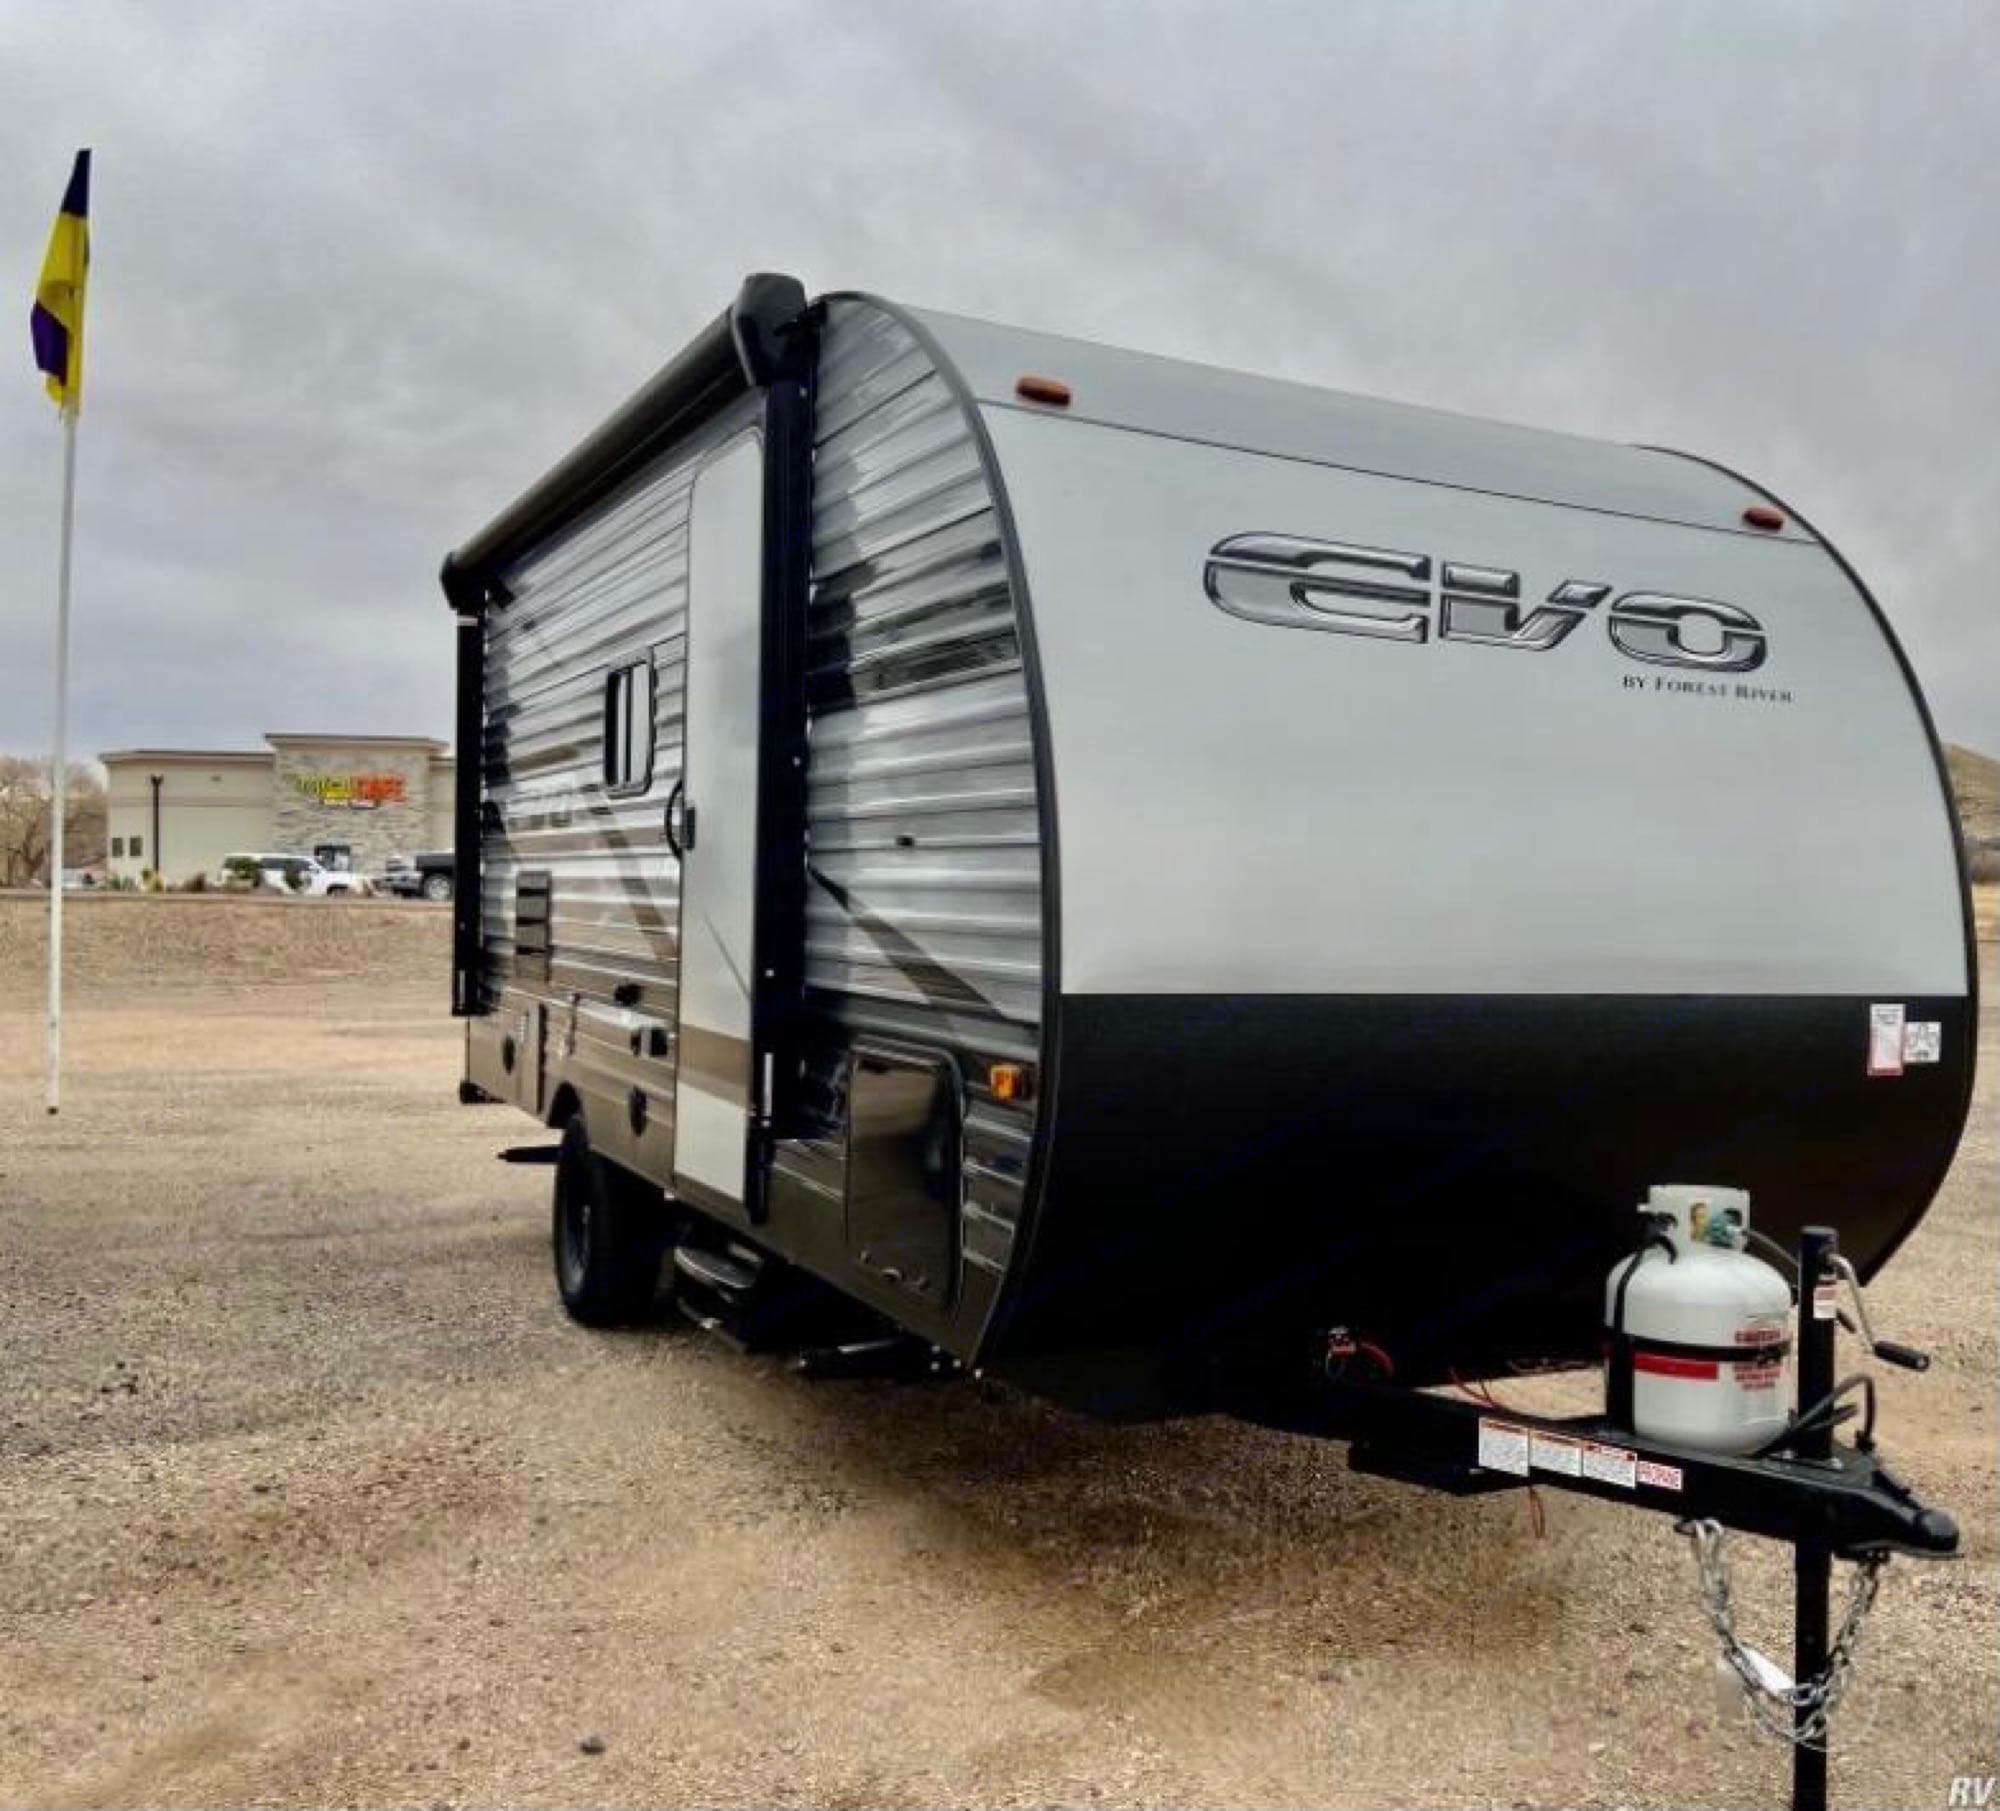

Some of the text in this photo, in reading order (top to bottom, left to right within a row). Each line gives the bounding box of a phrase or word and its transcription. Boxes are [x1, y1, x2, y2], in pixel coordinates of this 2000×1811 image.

[1203, 531, 1767, 673] EVO
[1622, 674, 1793, 703] BY FOREST RIVER
